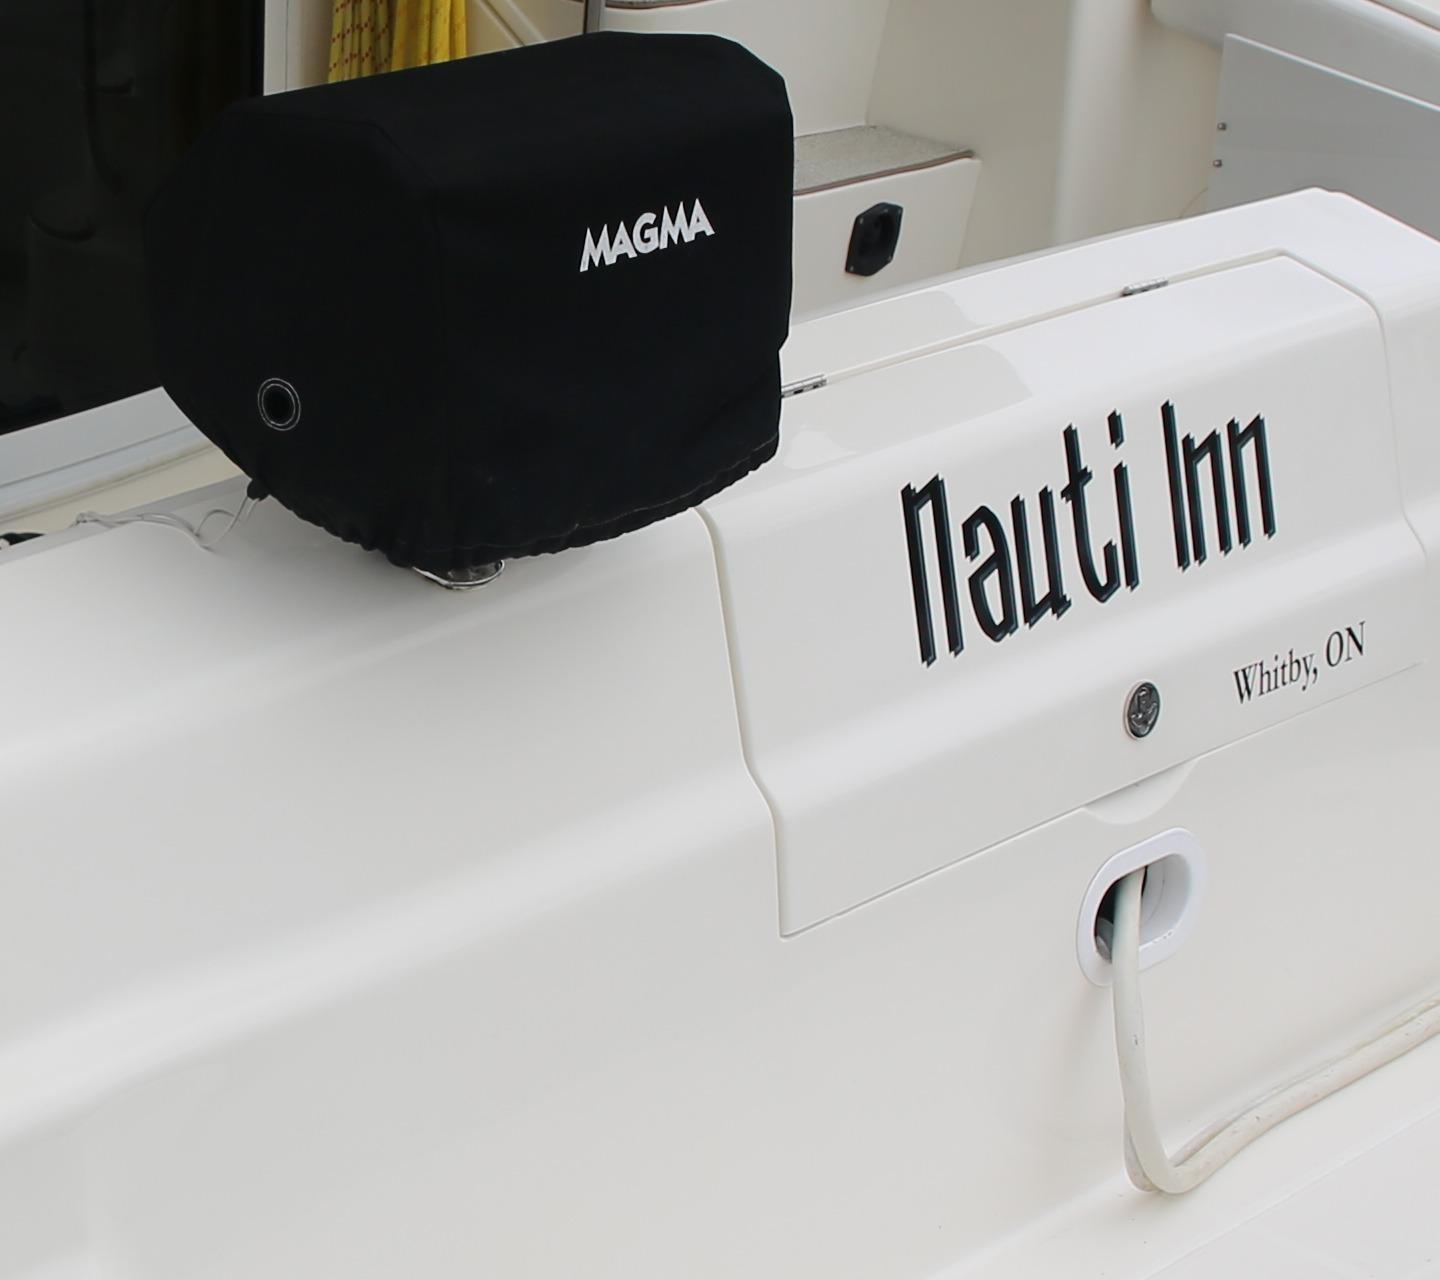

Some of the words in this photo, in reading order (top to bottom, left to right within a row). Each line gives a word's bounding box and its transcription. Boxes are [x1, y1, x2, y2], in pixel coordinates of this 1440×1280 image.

[579, 198, 715, 272] MAGMA
[901, 408, 1139, 668] Nauti
[1161, 399, 1276, 573] Inn
[1233, 648, 1318, 704] Whitby,
[1326, 621, 1366, 668] ON
